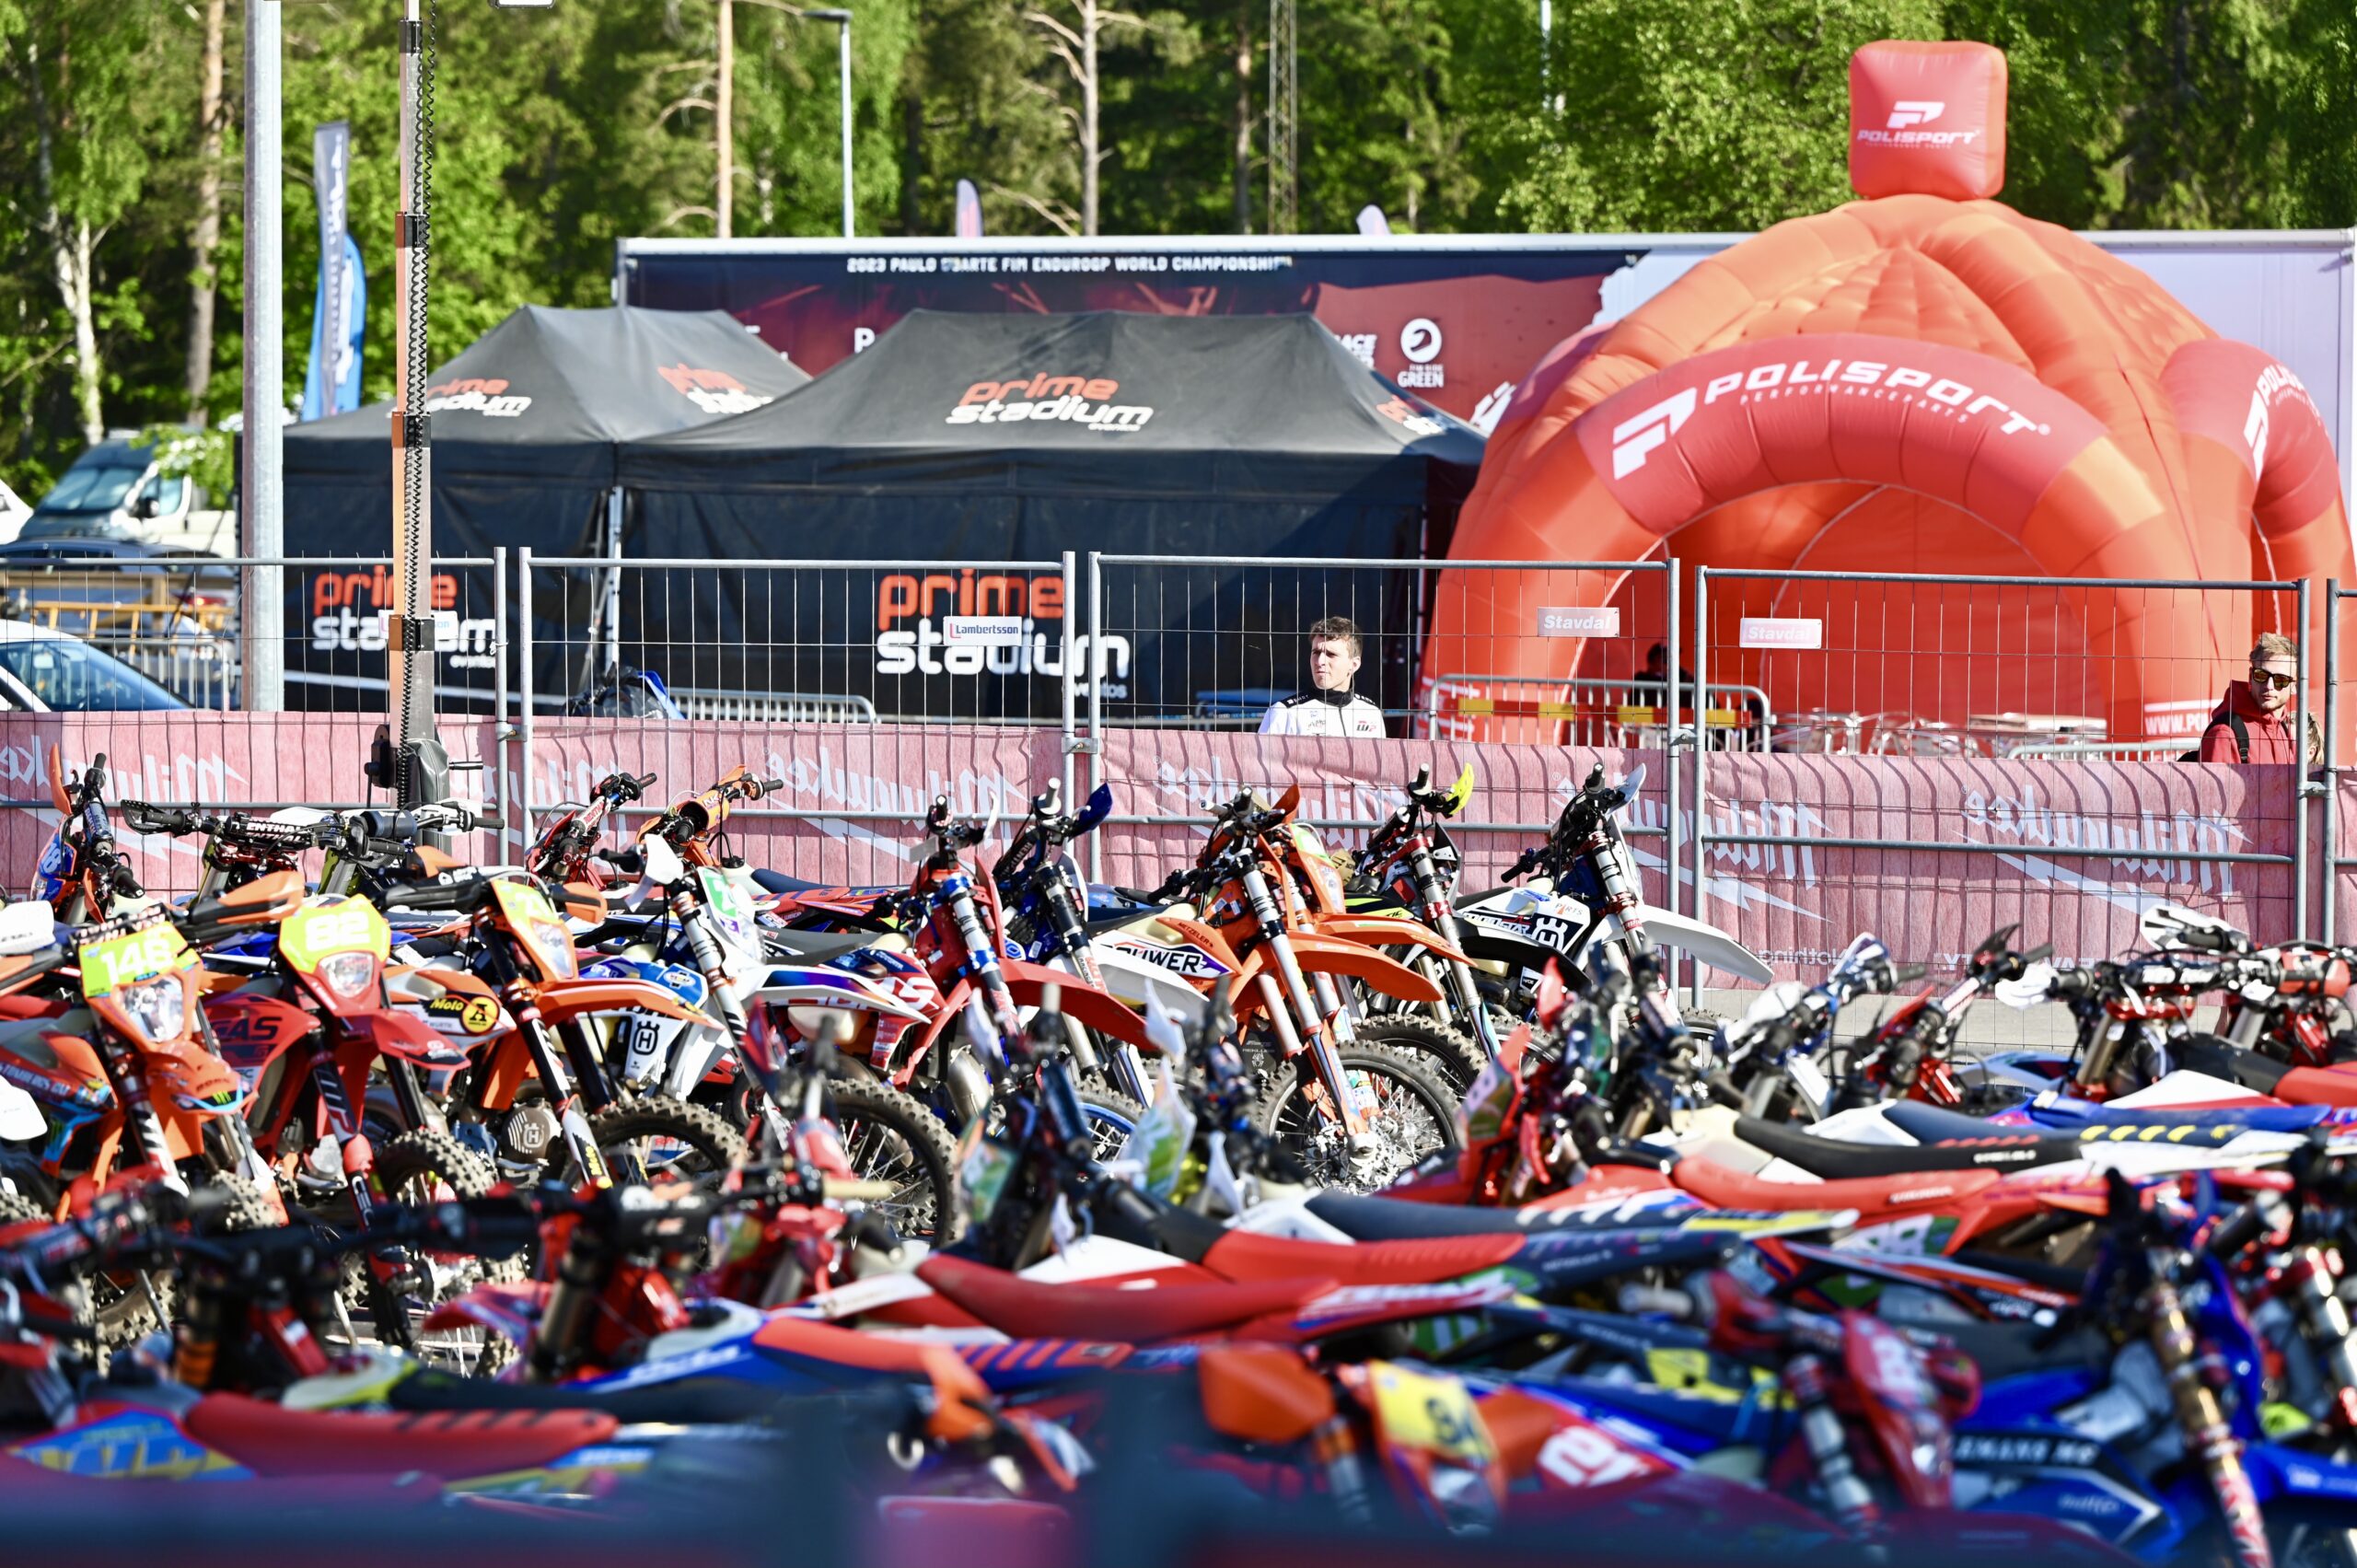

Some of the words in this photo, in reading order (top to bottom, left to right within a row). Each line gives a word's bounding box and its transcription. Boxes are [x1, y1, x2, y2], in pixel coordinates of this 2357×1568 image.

[847, 257, 887, 273] 2023
[889, 257, 937, 273] PAULO
[1115, 256, 1167, 272] WORLD
[958, 372, 1119, 406] prime
[1398, 371, 1445, 388] GREEN
[945, 394, 1155, 425] stadium
[1704, 359, 2038, 436] POLISPORT
[1740, 384, 1898, 406] PERFORMANCE
[1903, 393, 1968, 424] PARTS
[313, 565, 458, 617] prie
[877, 567, 1064, 631] prime
[956, 623, 1019, 634] Lambertsson
[1543, 614, 1610, 630] Stavdal
[1747, 626, 1811, 641] Stavdal
[306, 911, 370, 953] 82
[1177, 922, 1210, 946] METZELER
[430, 997, 465, 1012] Moto
